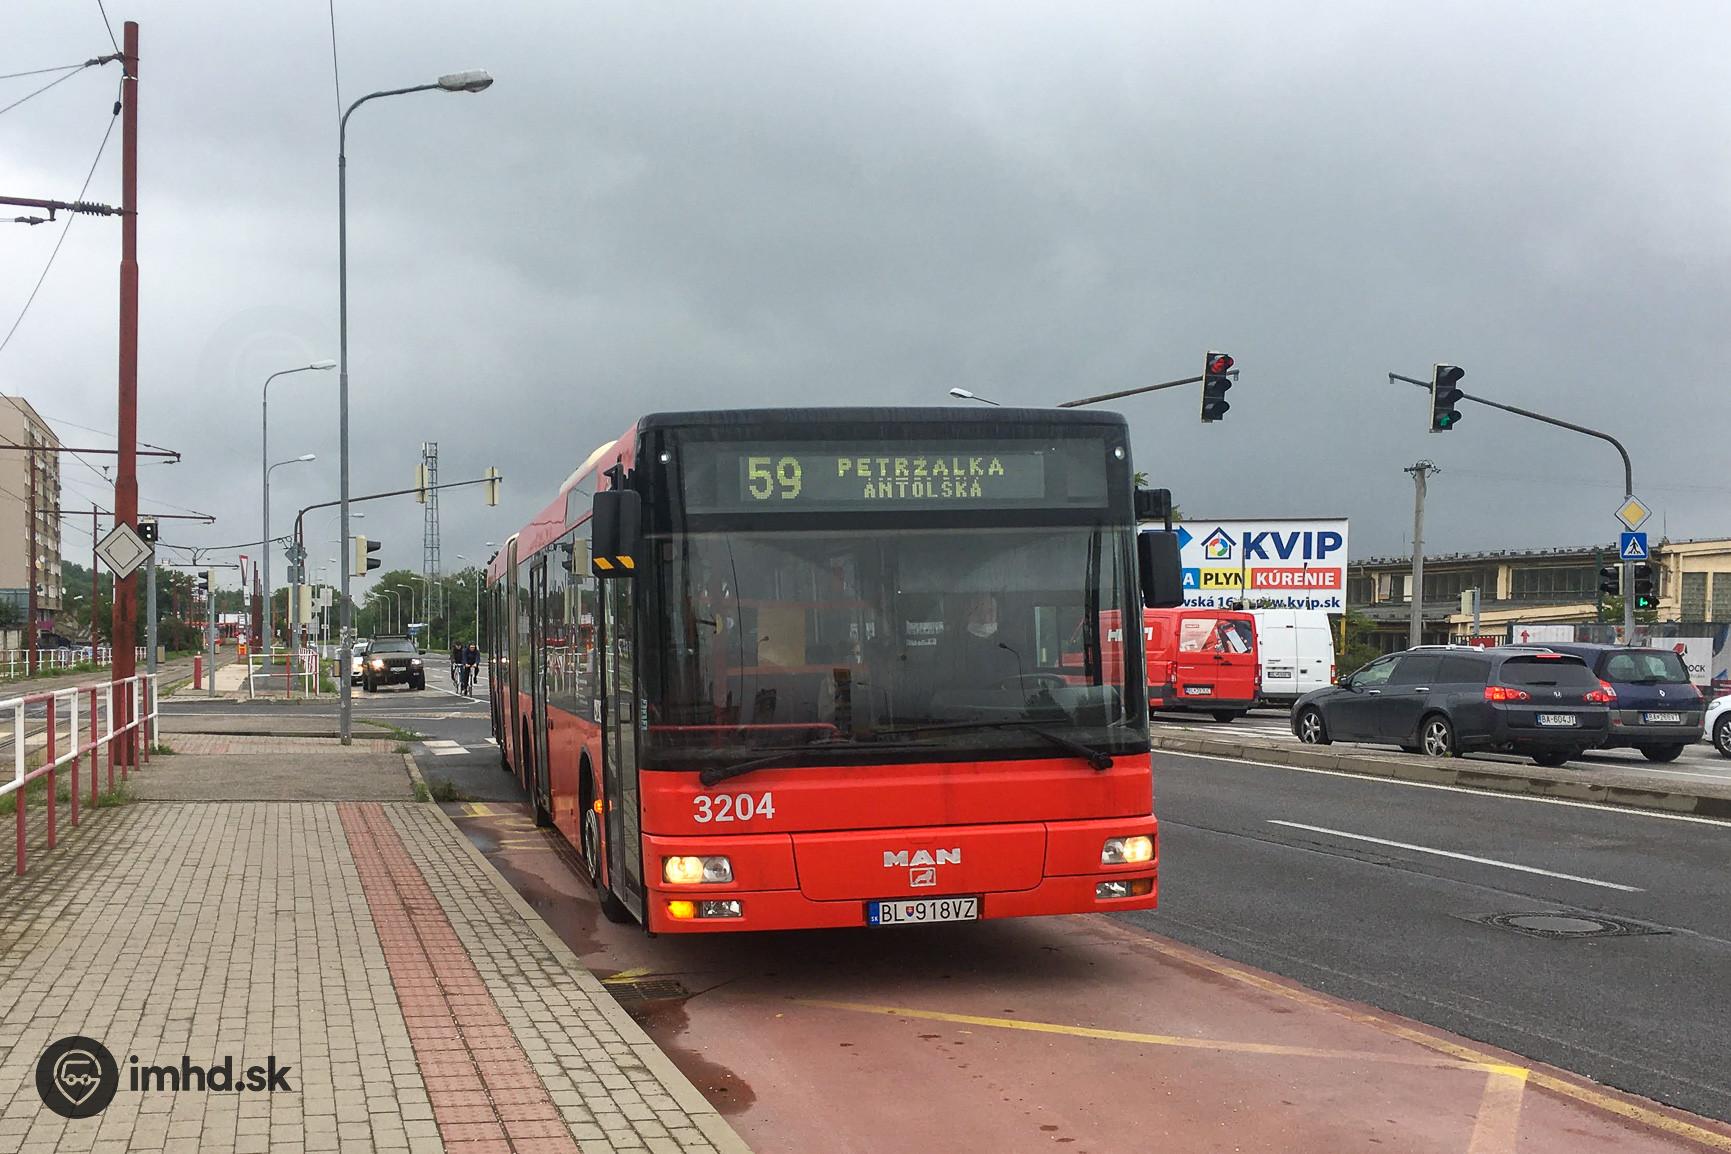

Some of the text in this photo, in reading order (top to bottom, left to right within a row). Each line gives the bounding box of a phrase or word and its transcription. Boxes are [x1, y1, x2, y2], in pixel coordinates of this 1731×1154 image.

[749, 457, 801, 499] 59
[1243, 531, 1343, 560] KVIP
[1256, 570, 1335, 586] KÚRENIE
[1183, 596, 1214, 608] vská
[693, 792, 775, 823] 3204
[883, 848, 960, 867] MAN
